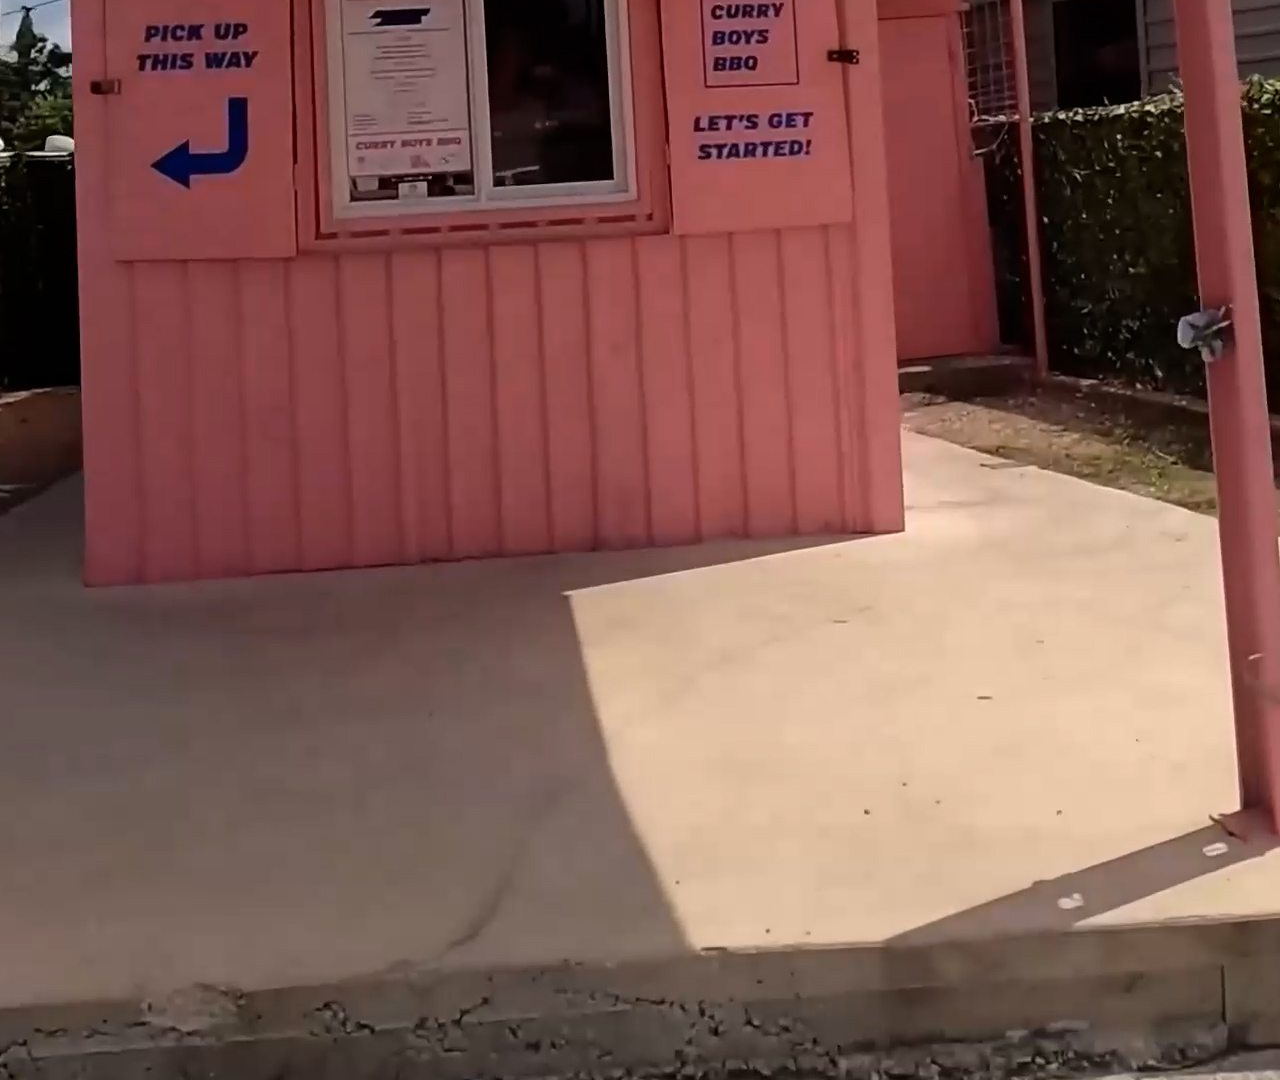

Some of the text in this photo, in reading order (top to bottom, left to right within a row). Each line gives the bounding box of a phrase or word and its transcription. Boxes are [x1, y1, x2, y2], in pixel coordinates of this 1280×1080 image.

[711, 3, 784, 20] CURRY
[144, 23, 249, 43] PICK UP
[711, 29, 769, 46] BOYS
[136, 51, 259, 71] THIS WAY
[712, 55, 758, 72] BBQ
[693, 111, 813, 132] LET'S GET
[356, 141, 397, 150] CURRY
[401, 139, 433, 148] BOYS
[697, 139, 811, 160] STARTED!
